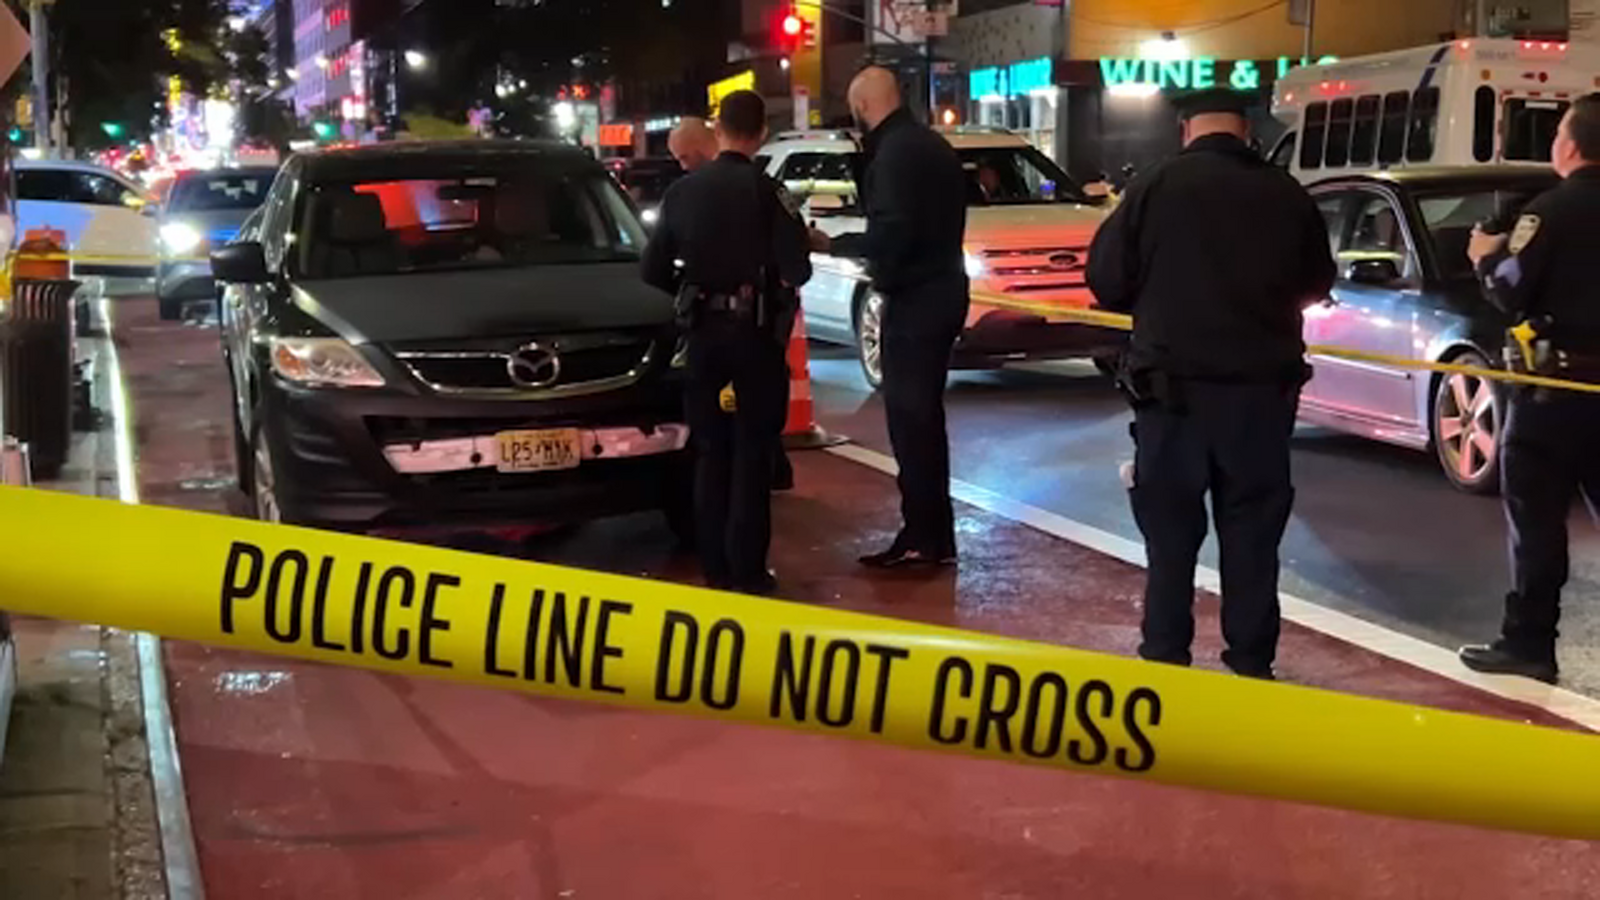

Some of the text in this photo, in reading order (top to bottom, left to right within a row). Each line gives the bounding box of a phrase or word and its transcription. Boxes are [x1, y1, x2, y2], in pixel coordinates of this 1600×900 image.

[1099, 56, 1215, 90] WINE
[1230, 59, 1259, 90] &
[220, 542, 1161, 772] POLICE LINE DO NOT CROSS
